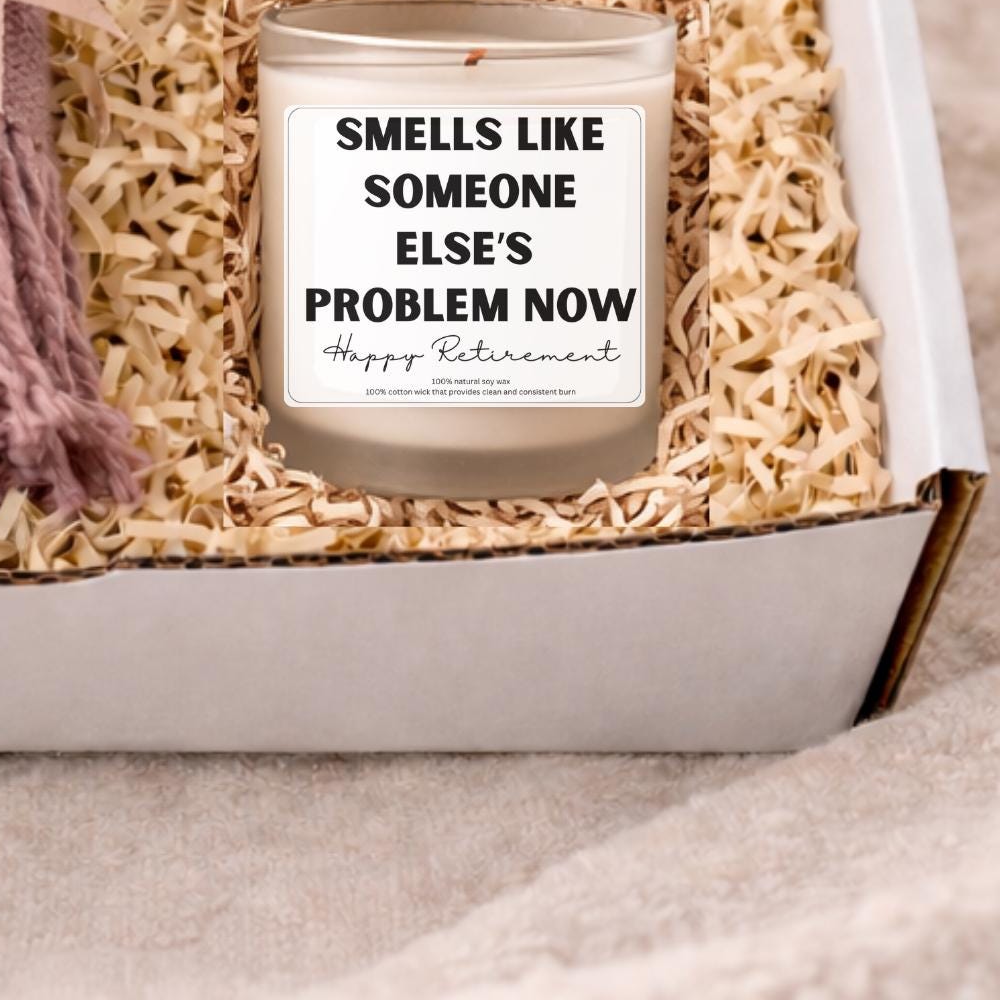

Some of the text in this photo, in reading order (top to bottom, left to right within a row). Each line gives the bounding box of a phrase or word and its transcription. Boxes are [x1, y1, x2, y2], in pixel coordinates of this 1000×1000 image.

[336, 116, 605, 151] SMELLS LIKE
[364, 172, 577, 209] SOMEONE
[305, 286, 637, 323] PROBLEM NOW
[322, 332, 621, 373] Happy Retirement
[366, 388, 387, 396] 100%
[413, 388, 431, 396] wick
[448, 388, 481, 397] provides
[481, 388, 502, 396] clean
[503, 388, 518, 396] and
[518, 388, 558, 396] consistent
[558, 388, 576, 396] burn
[431, 377, 453, 385] 100%
[454, 377, 481, 385] natural
[481, 379, 495, 387] soy
